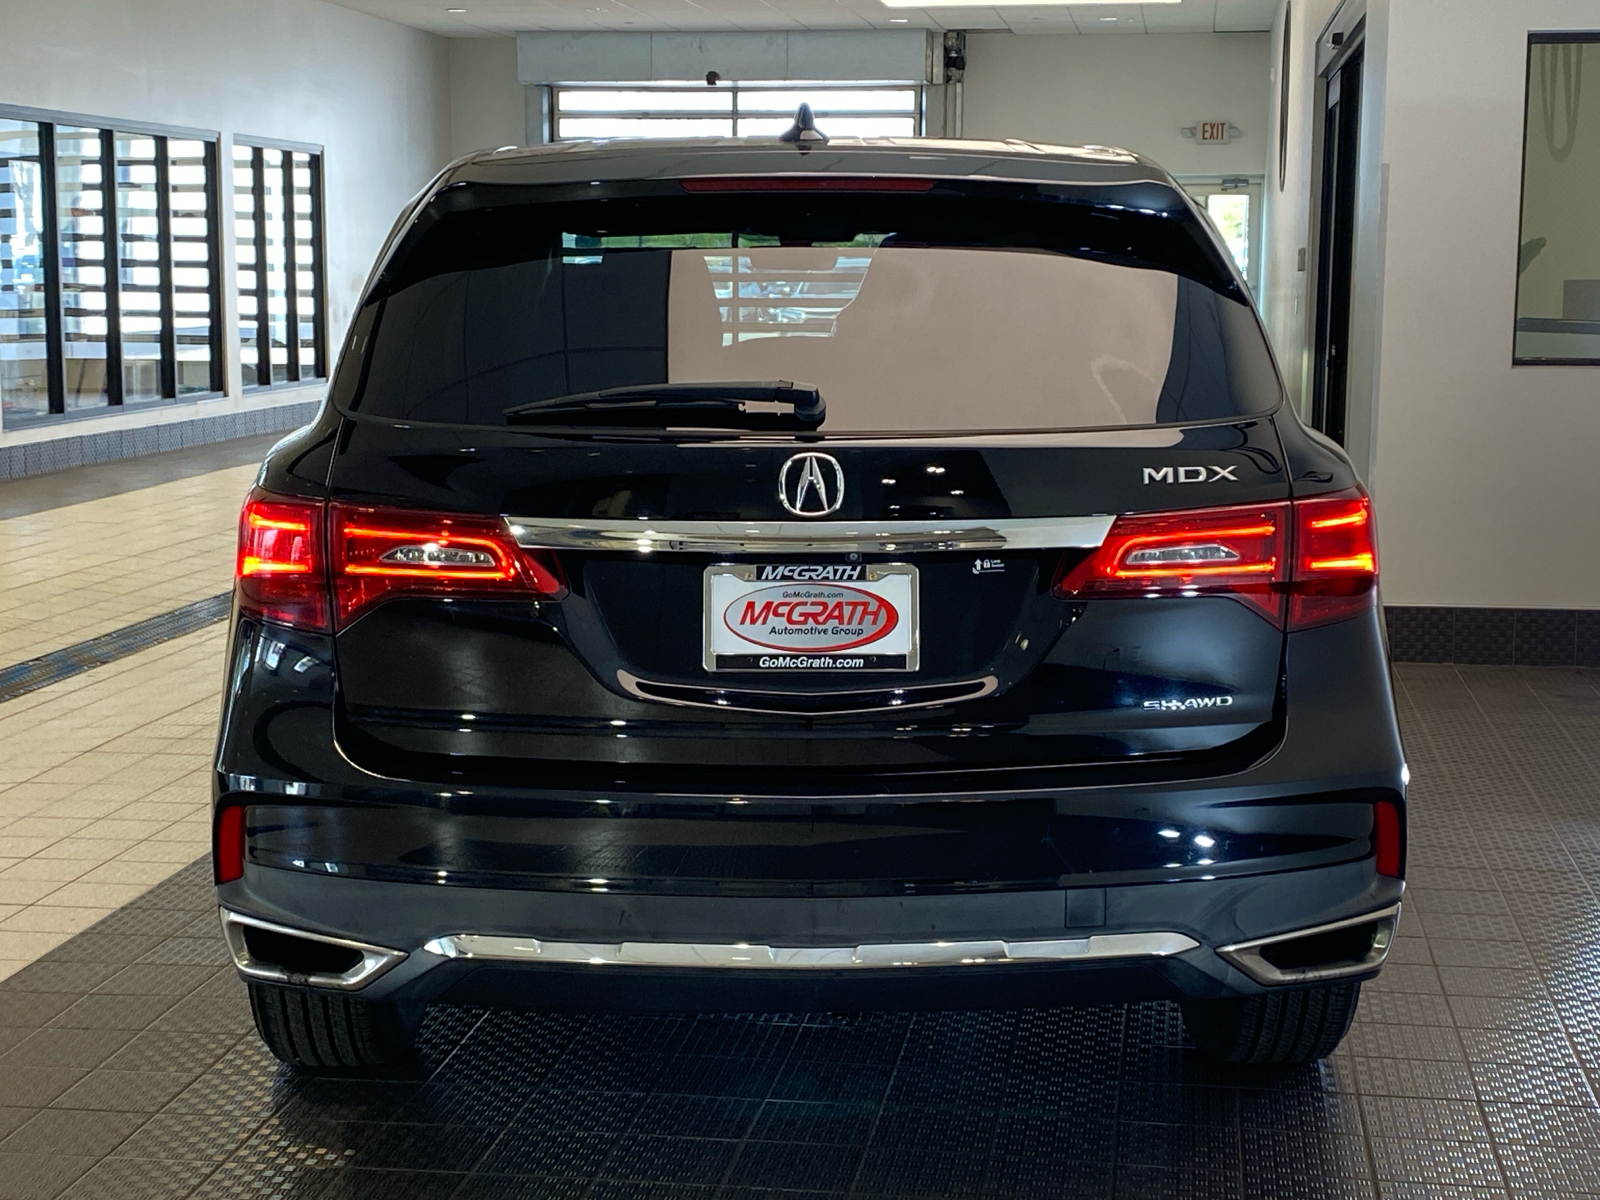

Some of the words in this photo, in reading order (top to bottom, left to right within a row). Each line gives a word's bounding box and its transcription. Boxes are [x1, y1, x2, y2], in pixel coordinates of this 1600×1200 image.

[1202, 122, 1226, 140] EXIT
[1142, 465, 1240, 485] MDX
[782, 591, 844, 599] GoMcGrath.com
[769, 626, 828, 636] Automotive
[832, 626, 864, 637] Group
[759, 656, 864, 669] GoMcGrath.com
